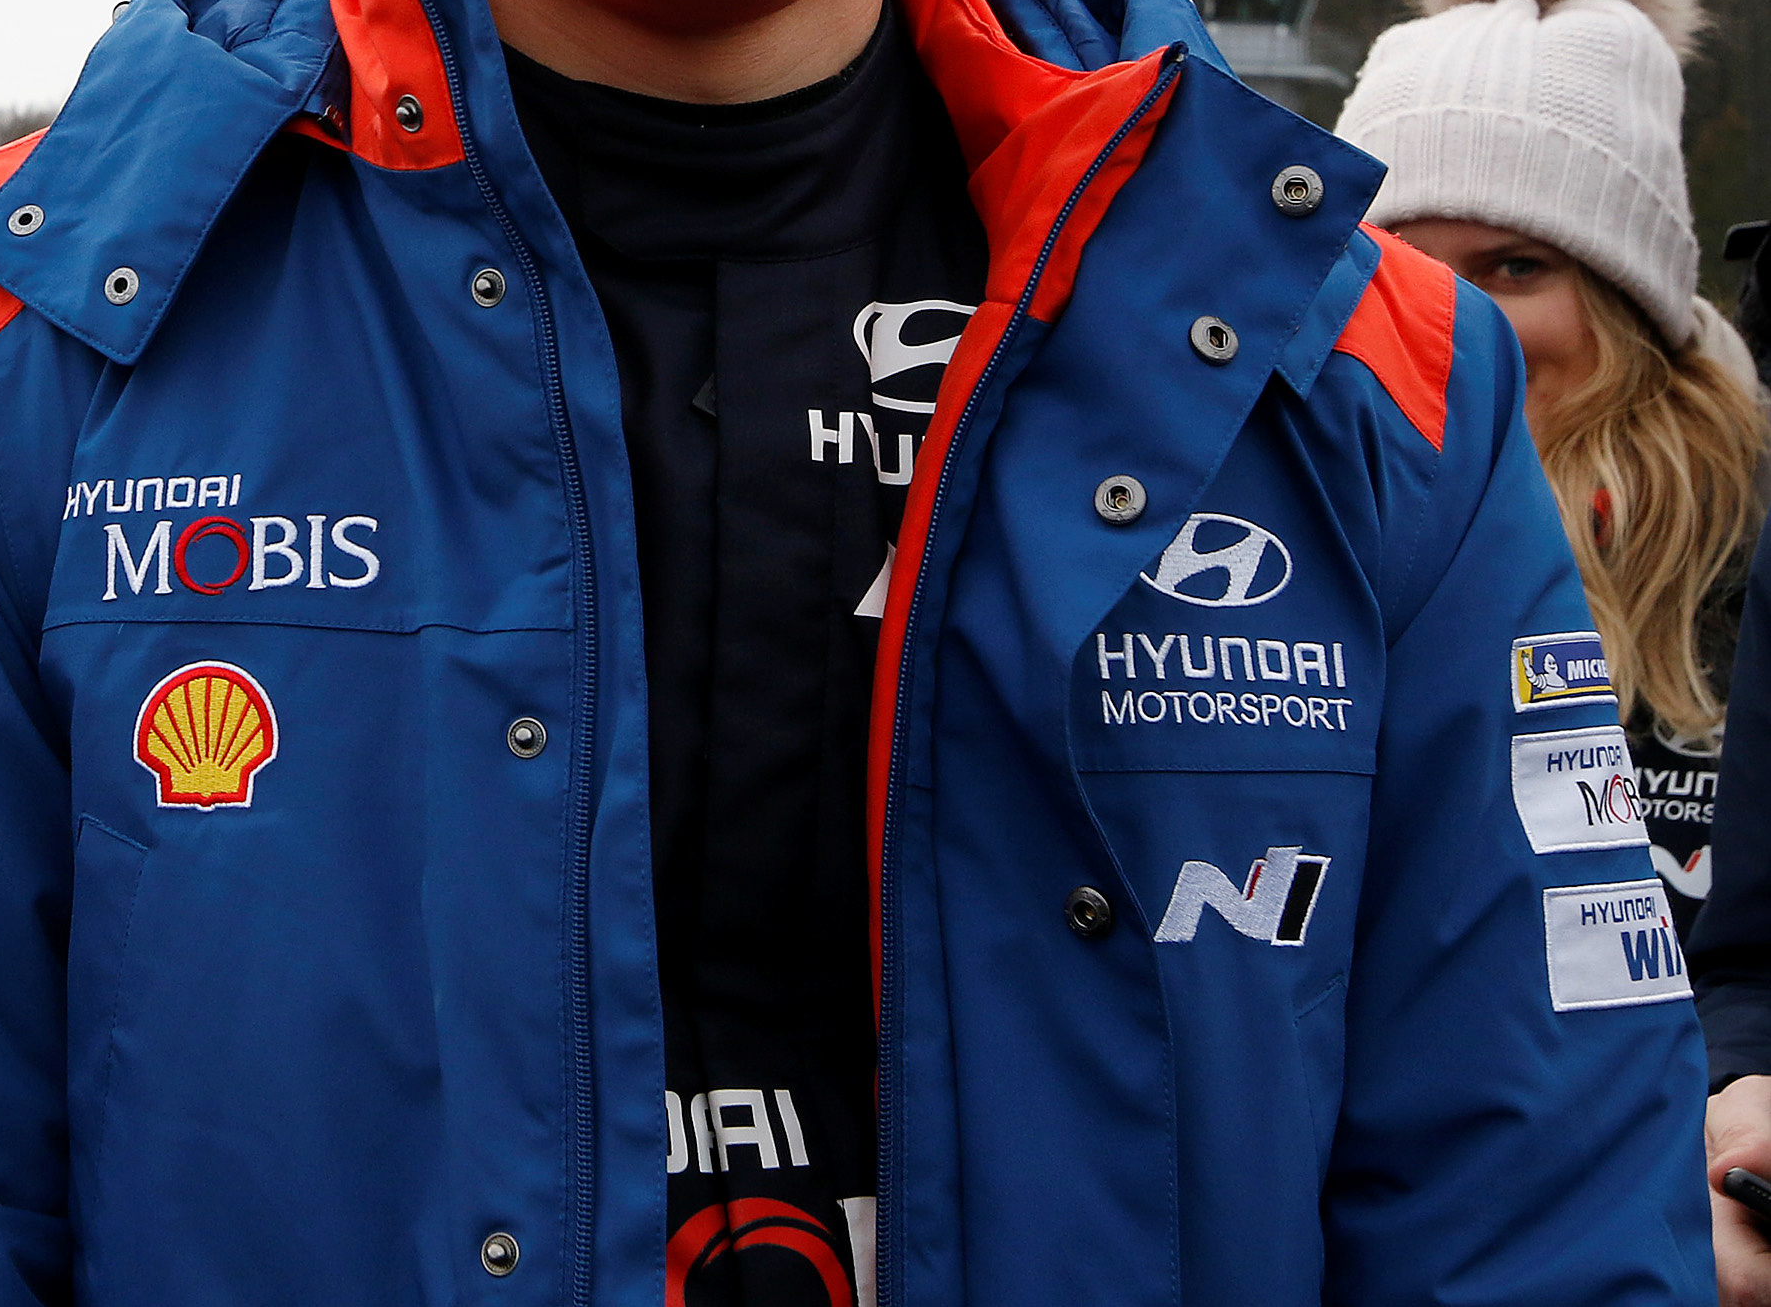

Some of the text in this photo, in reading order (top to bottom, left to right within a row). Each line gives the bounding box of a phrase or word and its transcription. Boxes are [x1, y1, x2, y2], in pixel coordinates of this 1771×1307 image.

[63, 473, 242, 520] HYUNDAI
[101, 515, 380, 601] MOBIS
[1096, 633, 1346, 687] HYUNDAI
[1101, 690, 1353, 731] MOTORSPORT
[1547, 745, 1623, 773] HYUNDA
[1575, 774, 1644, 826] MOB
[1581, 896, 1656, 926] HYUNDAI
